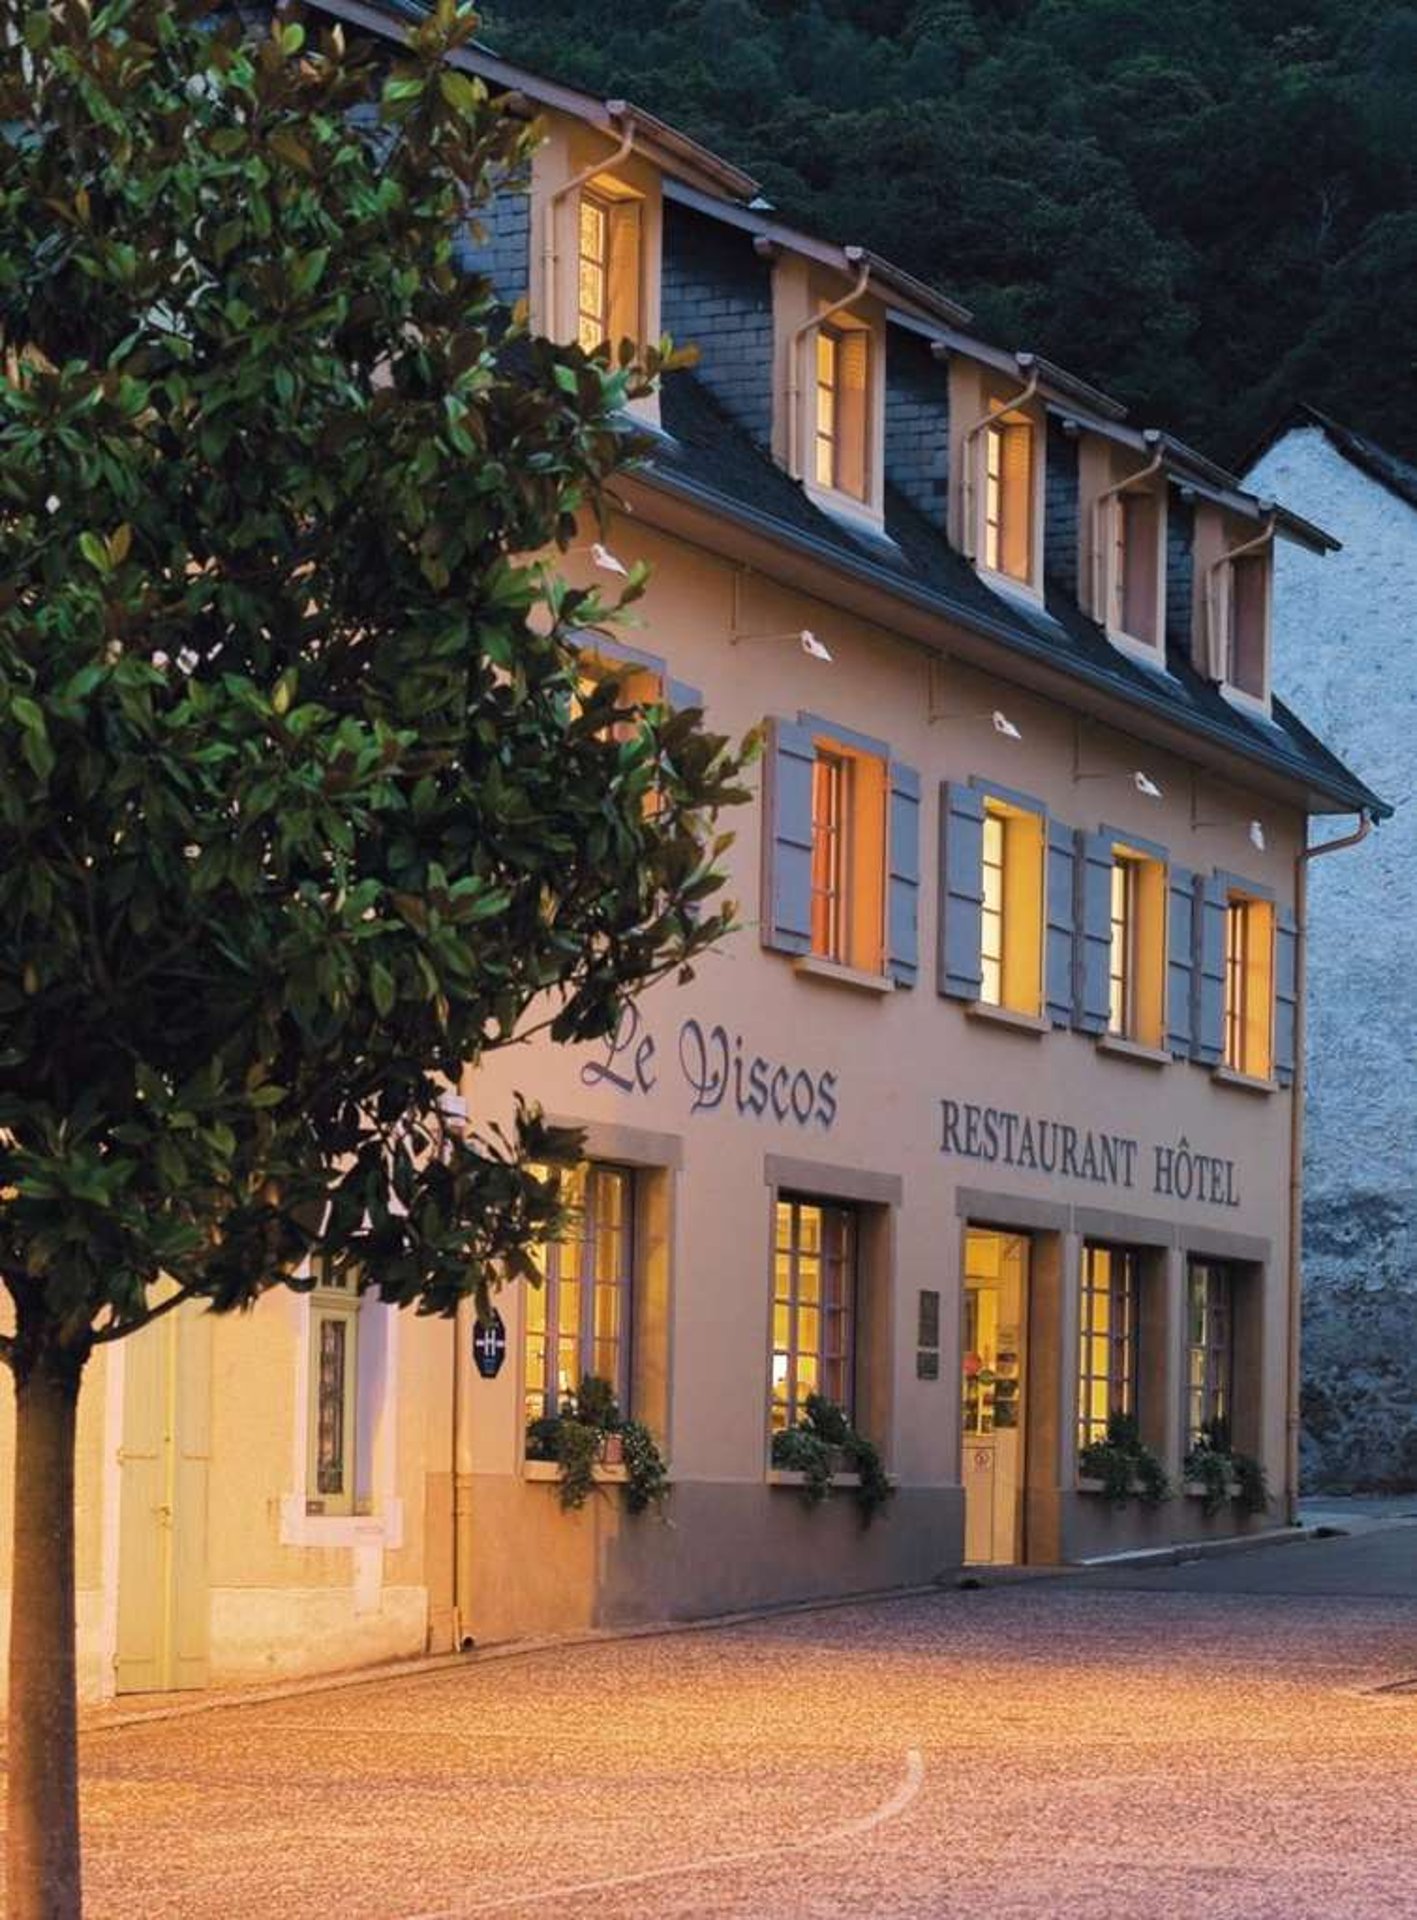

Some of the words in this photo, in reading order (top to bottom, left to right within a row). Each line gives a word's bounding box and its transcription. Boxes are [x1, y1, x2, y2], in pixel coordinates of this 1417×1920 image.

[580, 996, 656, 1094] Le
[679, 1019, 838, 1128] Viscos
[940, 1099, 1138, 1187] RESTAURANT
[1153, 1137, 1240, 1206] HÔTEL
